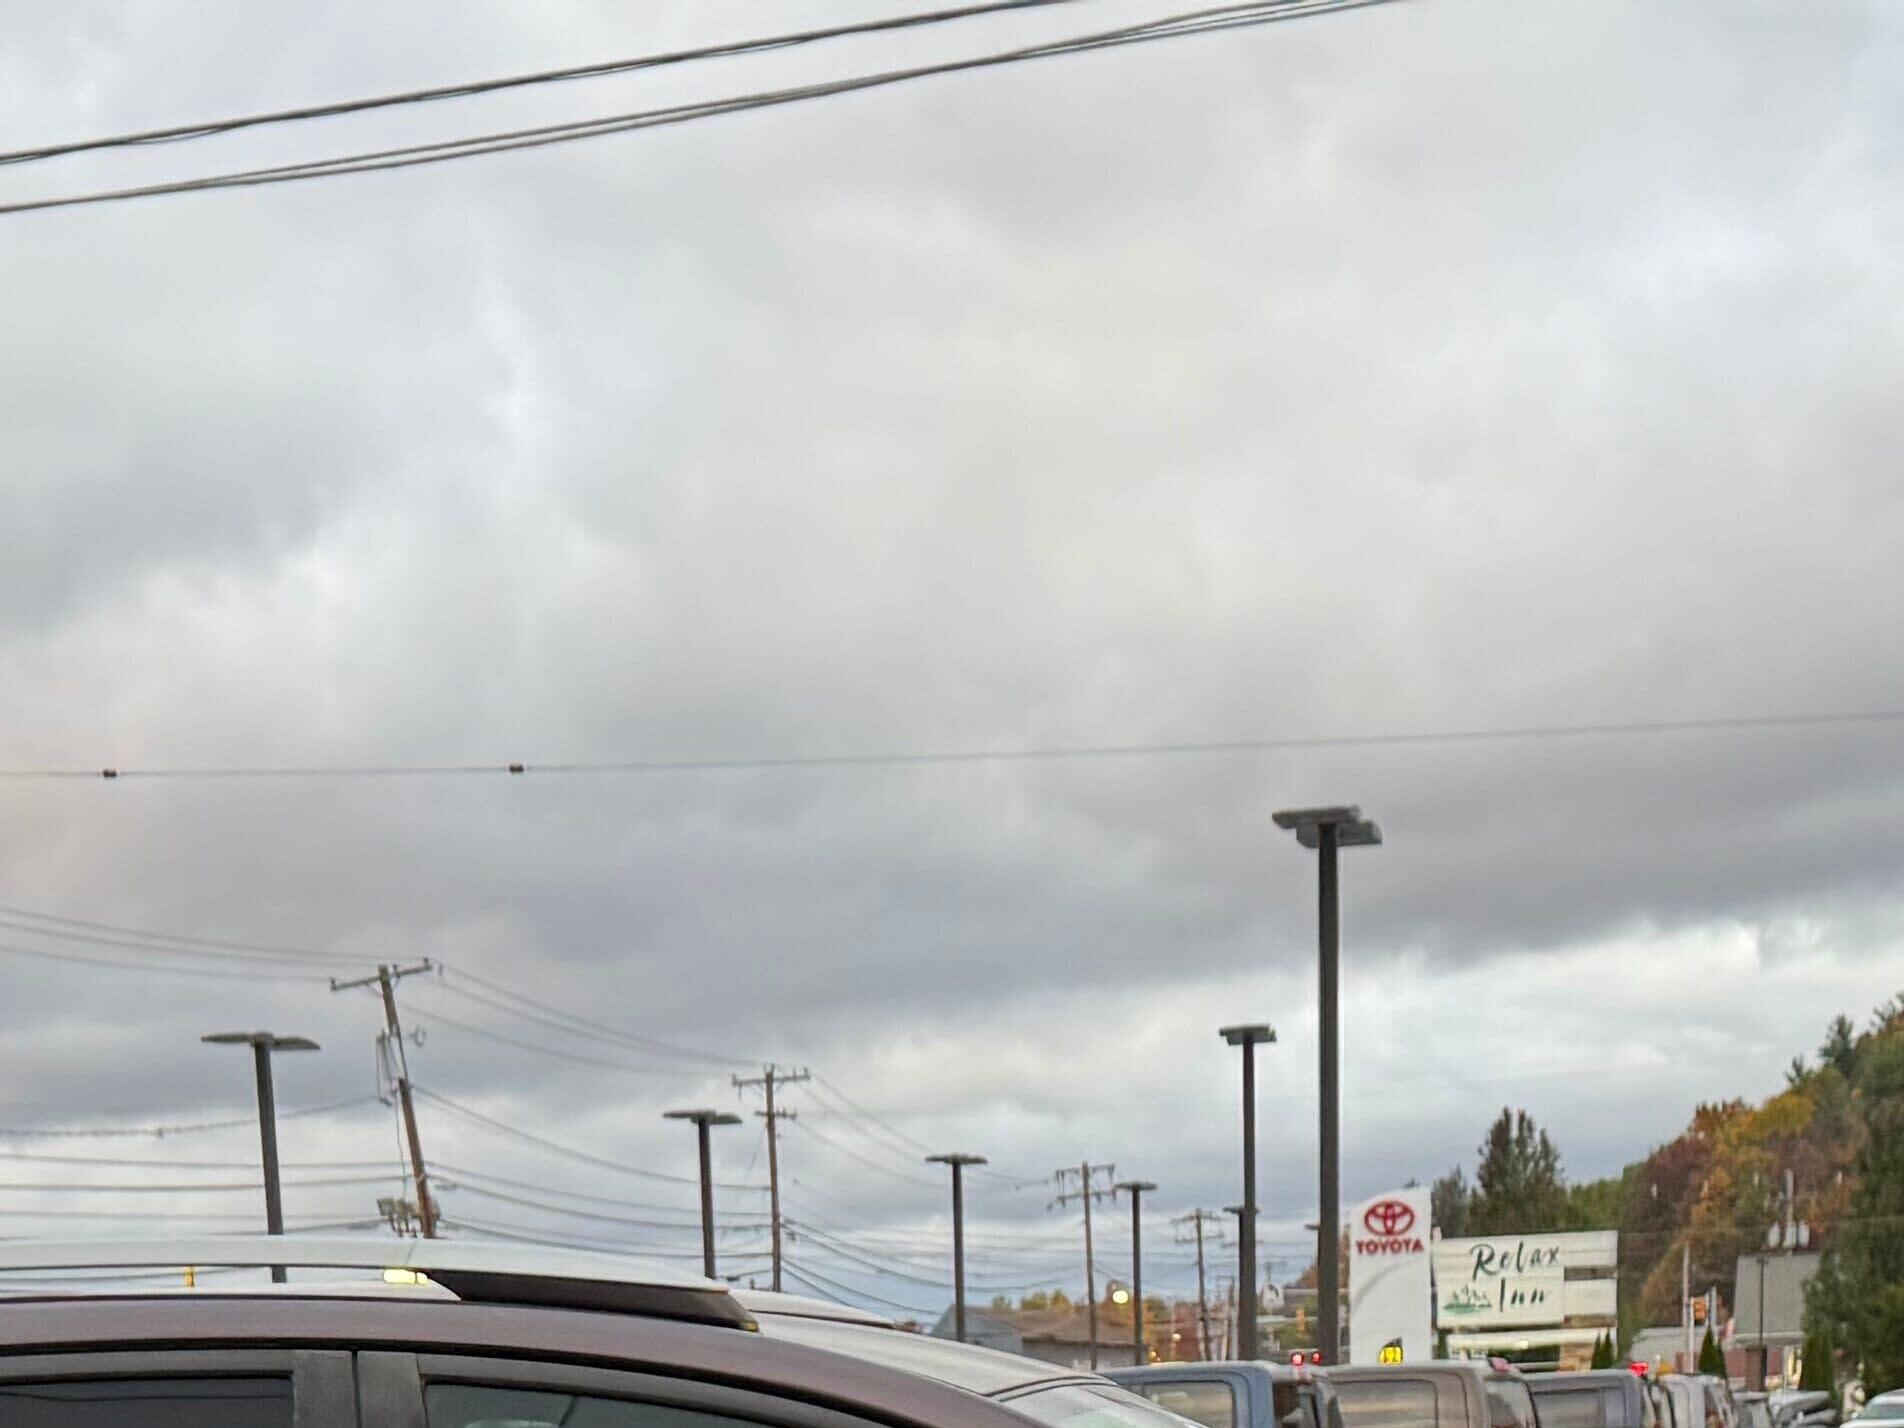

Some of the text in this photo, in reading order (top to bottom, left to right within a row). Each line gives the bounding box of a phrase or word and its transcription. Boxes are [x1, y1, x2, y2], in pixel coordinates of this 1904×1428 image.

[1355, 1238, 1424, 1256] TOYOTA
[1470, 1241, 1560, 1281] Relax
[1499, 1278, 1546, 1313] Inn
